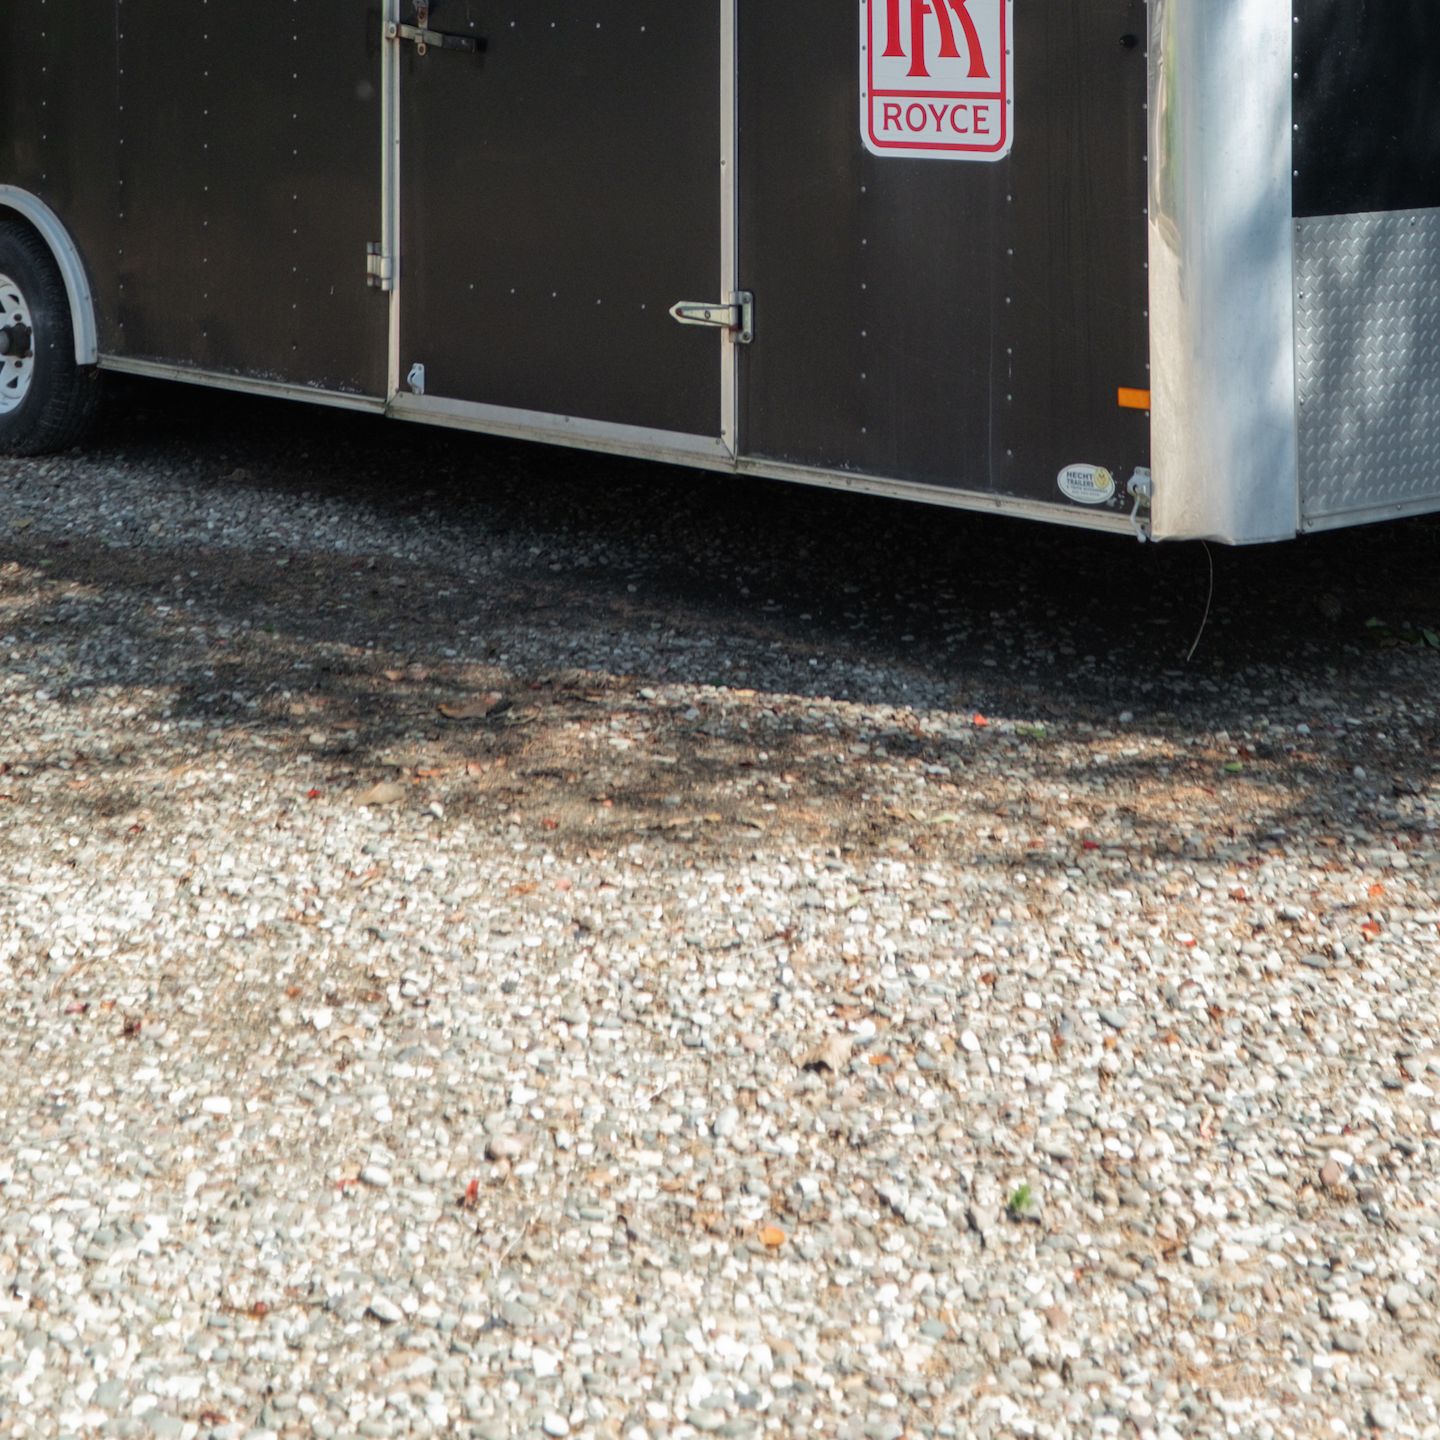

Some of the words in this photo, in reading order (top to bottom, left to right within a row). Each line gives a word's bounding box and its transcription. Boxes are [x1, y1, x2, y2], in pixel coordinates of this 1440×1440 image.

[882, 102, 991, 135] ROYCE
[1066, 471, 1093, 480] HECHT
[1067, 478, 1094, 488] TRAILERS
